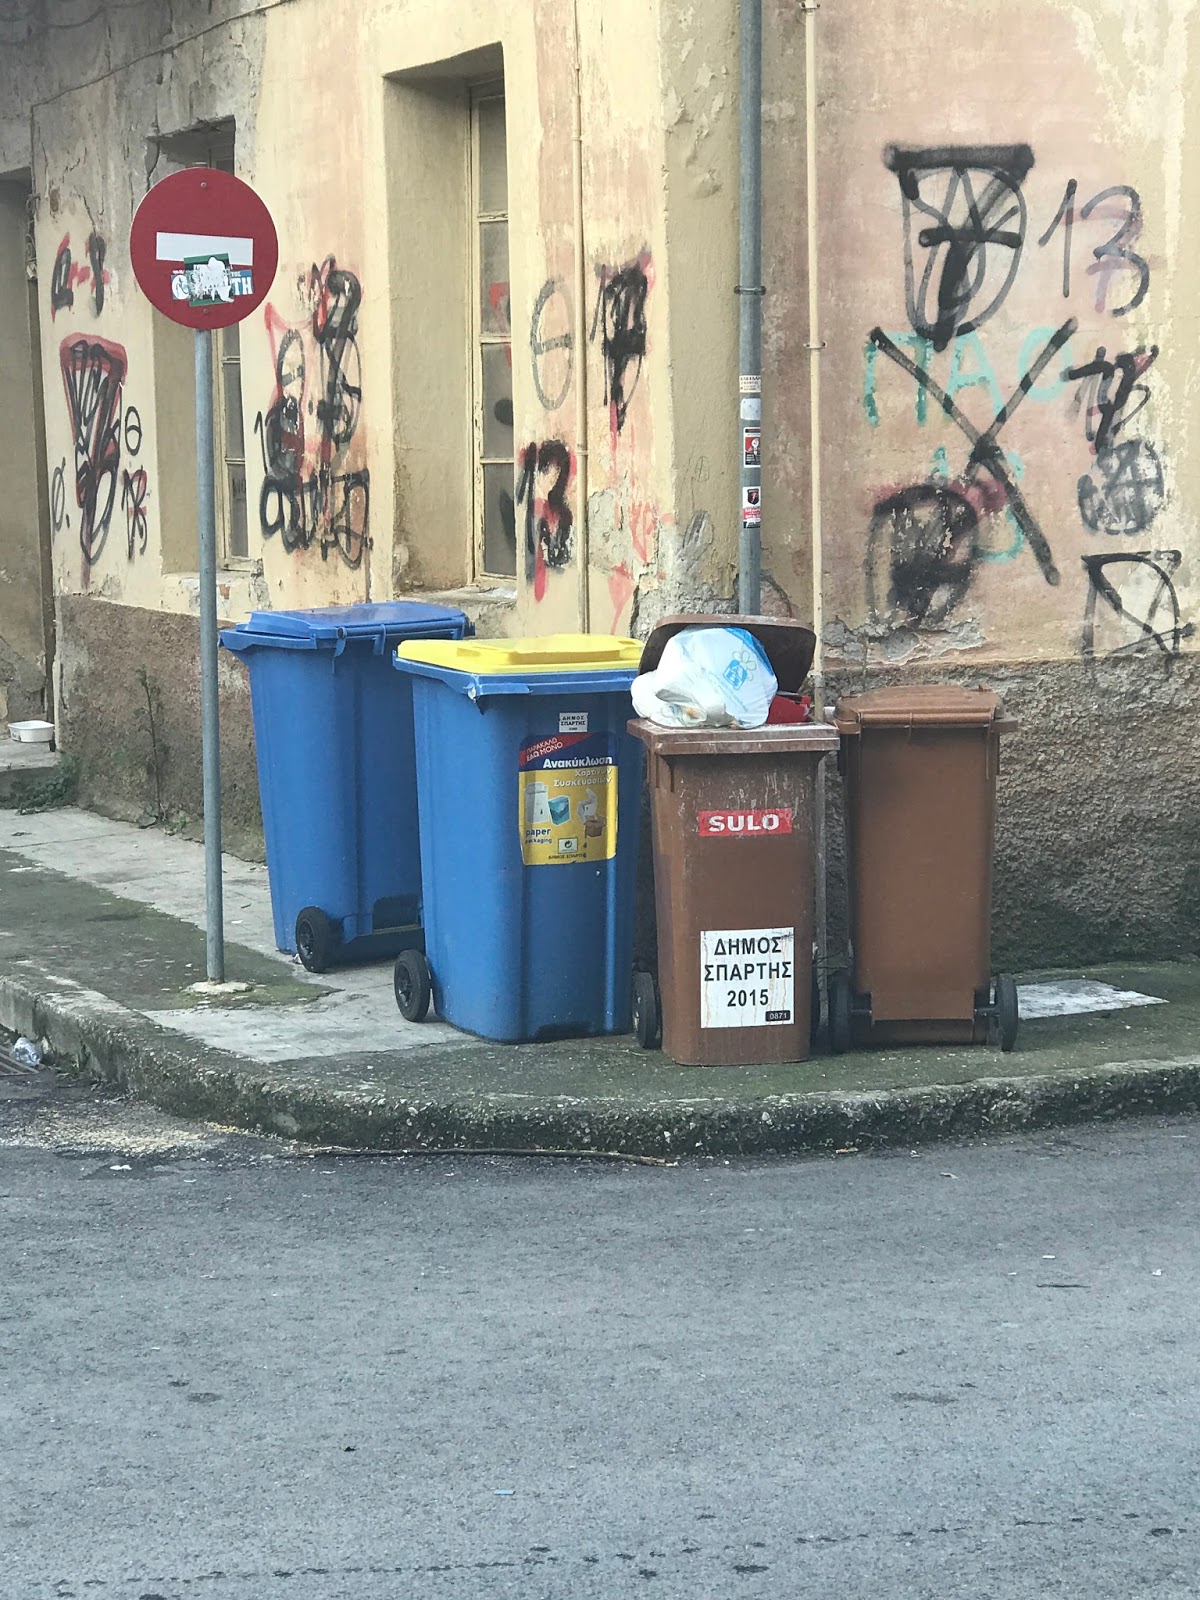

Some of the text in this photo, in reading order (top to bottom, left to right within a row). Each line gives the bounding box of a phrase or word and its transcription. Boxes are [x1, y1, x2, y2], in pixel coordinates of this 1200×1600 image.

[1038, 178, 1150, 317] 13
[863, 324, 1074, 428] ΠΑΟ
[526, 737, 558, 755] ΠΑΡΑΚΑΛΩ
[526, 741, 563, 762] ΕΔΩ ΜΟΝΟ
[543, 756, 613, 769] Ανακύκλωση
[708, 813, 780, 832] SULO
[525, 828, 551, 837] paper
[714, 936, 782, 956] ΔΗΜΟΣ
[704, 961, 792, 982] ΣΠΑΡΤΗΣ
[727, 989, 769, 1007] 2015
[769, 1011, 788, 1020] 0871
